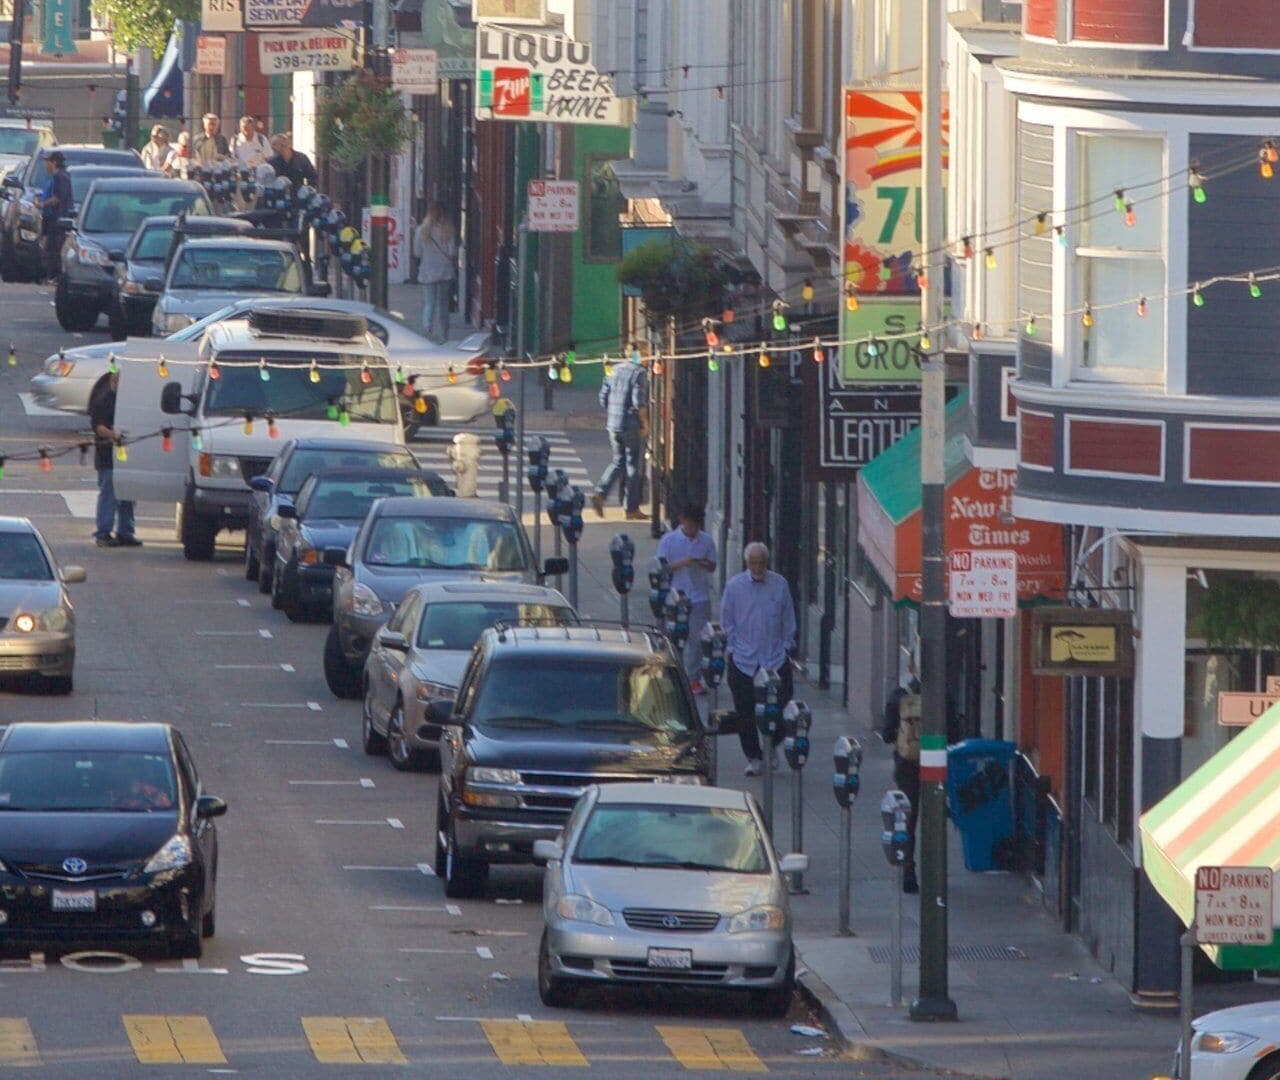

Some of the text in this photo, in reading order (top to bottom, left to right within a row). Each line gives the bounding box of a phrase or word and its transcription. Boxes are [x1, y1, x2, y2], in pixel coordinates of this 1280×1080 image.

[250, 8, 302, 21] SERVICE
[263, 41, 285, 53] PICK
[274, 54, 340, 69] 398-7226
[547, 69, 611, 94] BEER
[544, 94, 612, 120] WINE
[979, 470, 1018, 491] The
[951, 496, 996, 520] New
[969, 523, 1031, 547] Times
[953, 553, 1014, 570] NO PARKING
[1199, 868, 1270, 889] NO PARKING
[1205, 914, 1223, 927] MON
[1226, 914, 1245, 927] WED
